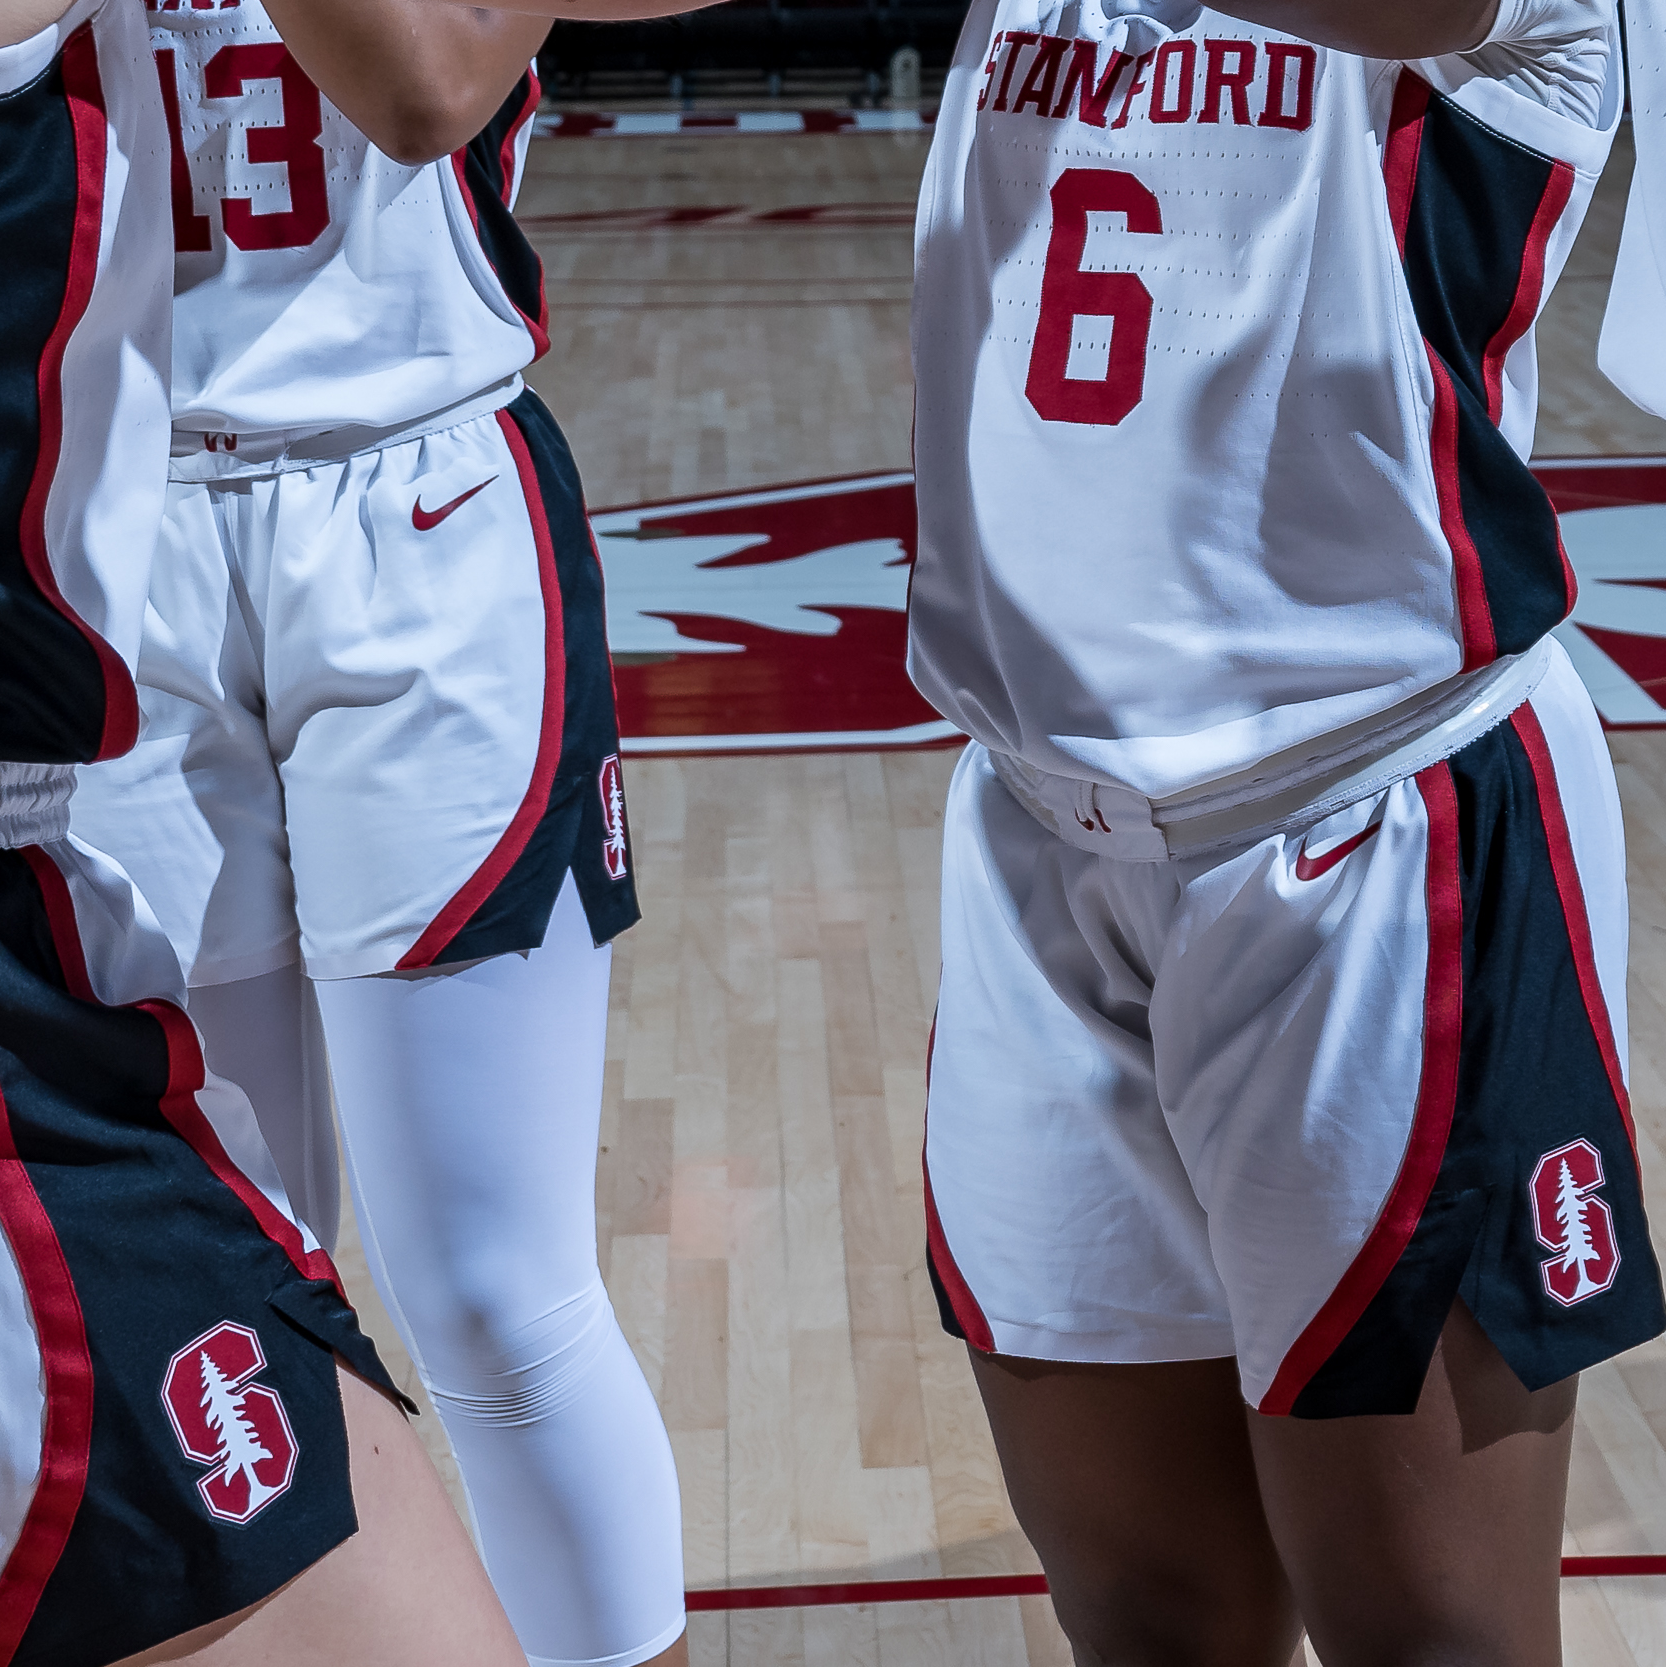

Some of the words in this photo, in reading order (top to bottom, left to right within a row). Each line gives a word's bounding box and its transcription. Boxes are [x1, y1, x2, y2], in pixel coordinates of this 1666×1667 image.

[153, 42, 331, 252] 13
[977, 30, 1317, 132] STANFORD
[1025, 168, 1164, 426] 6
